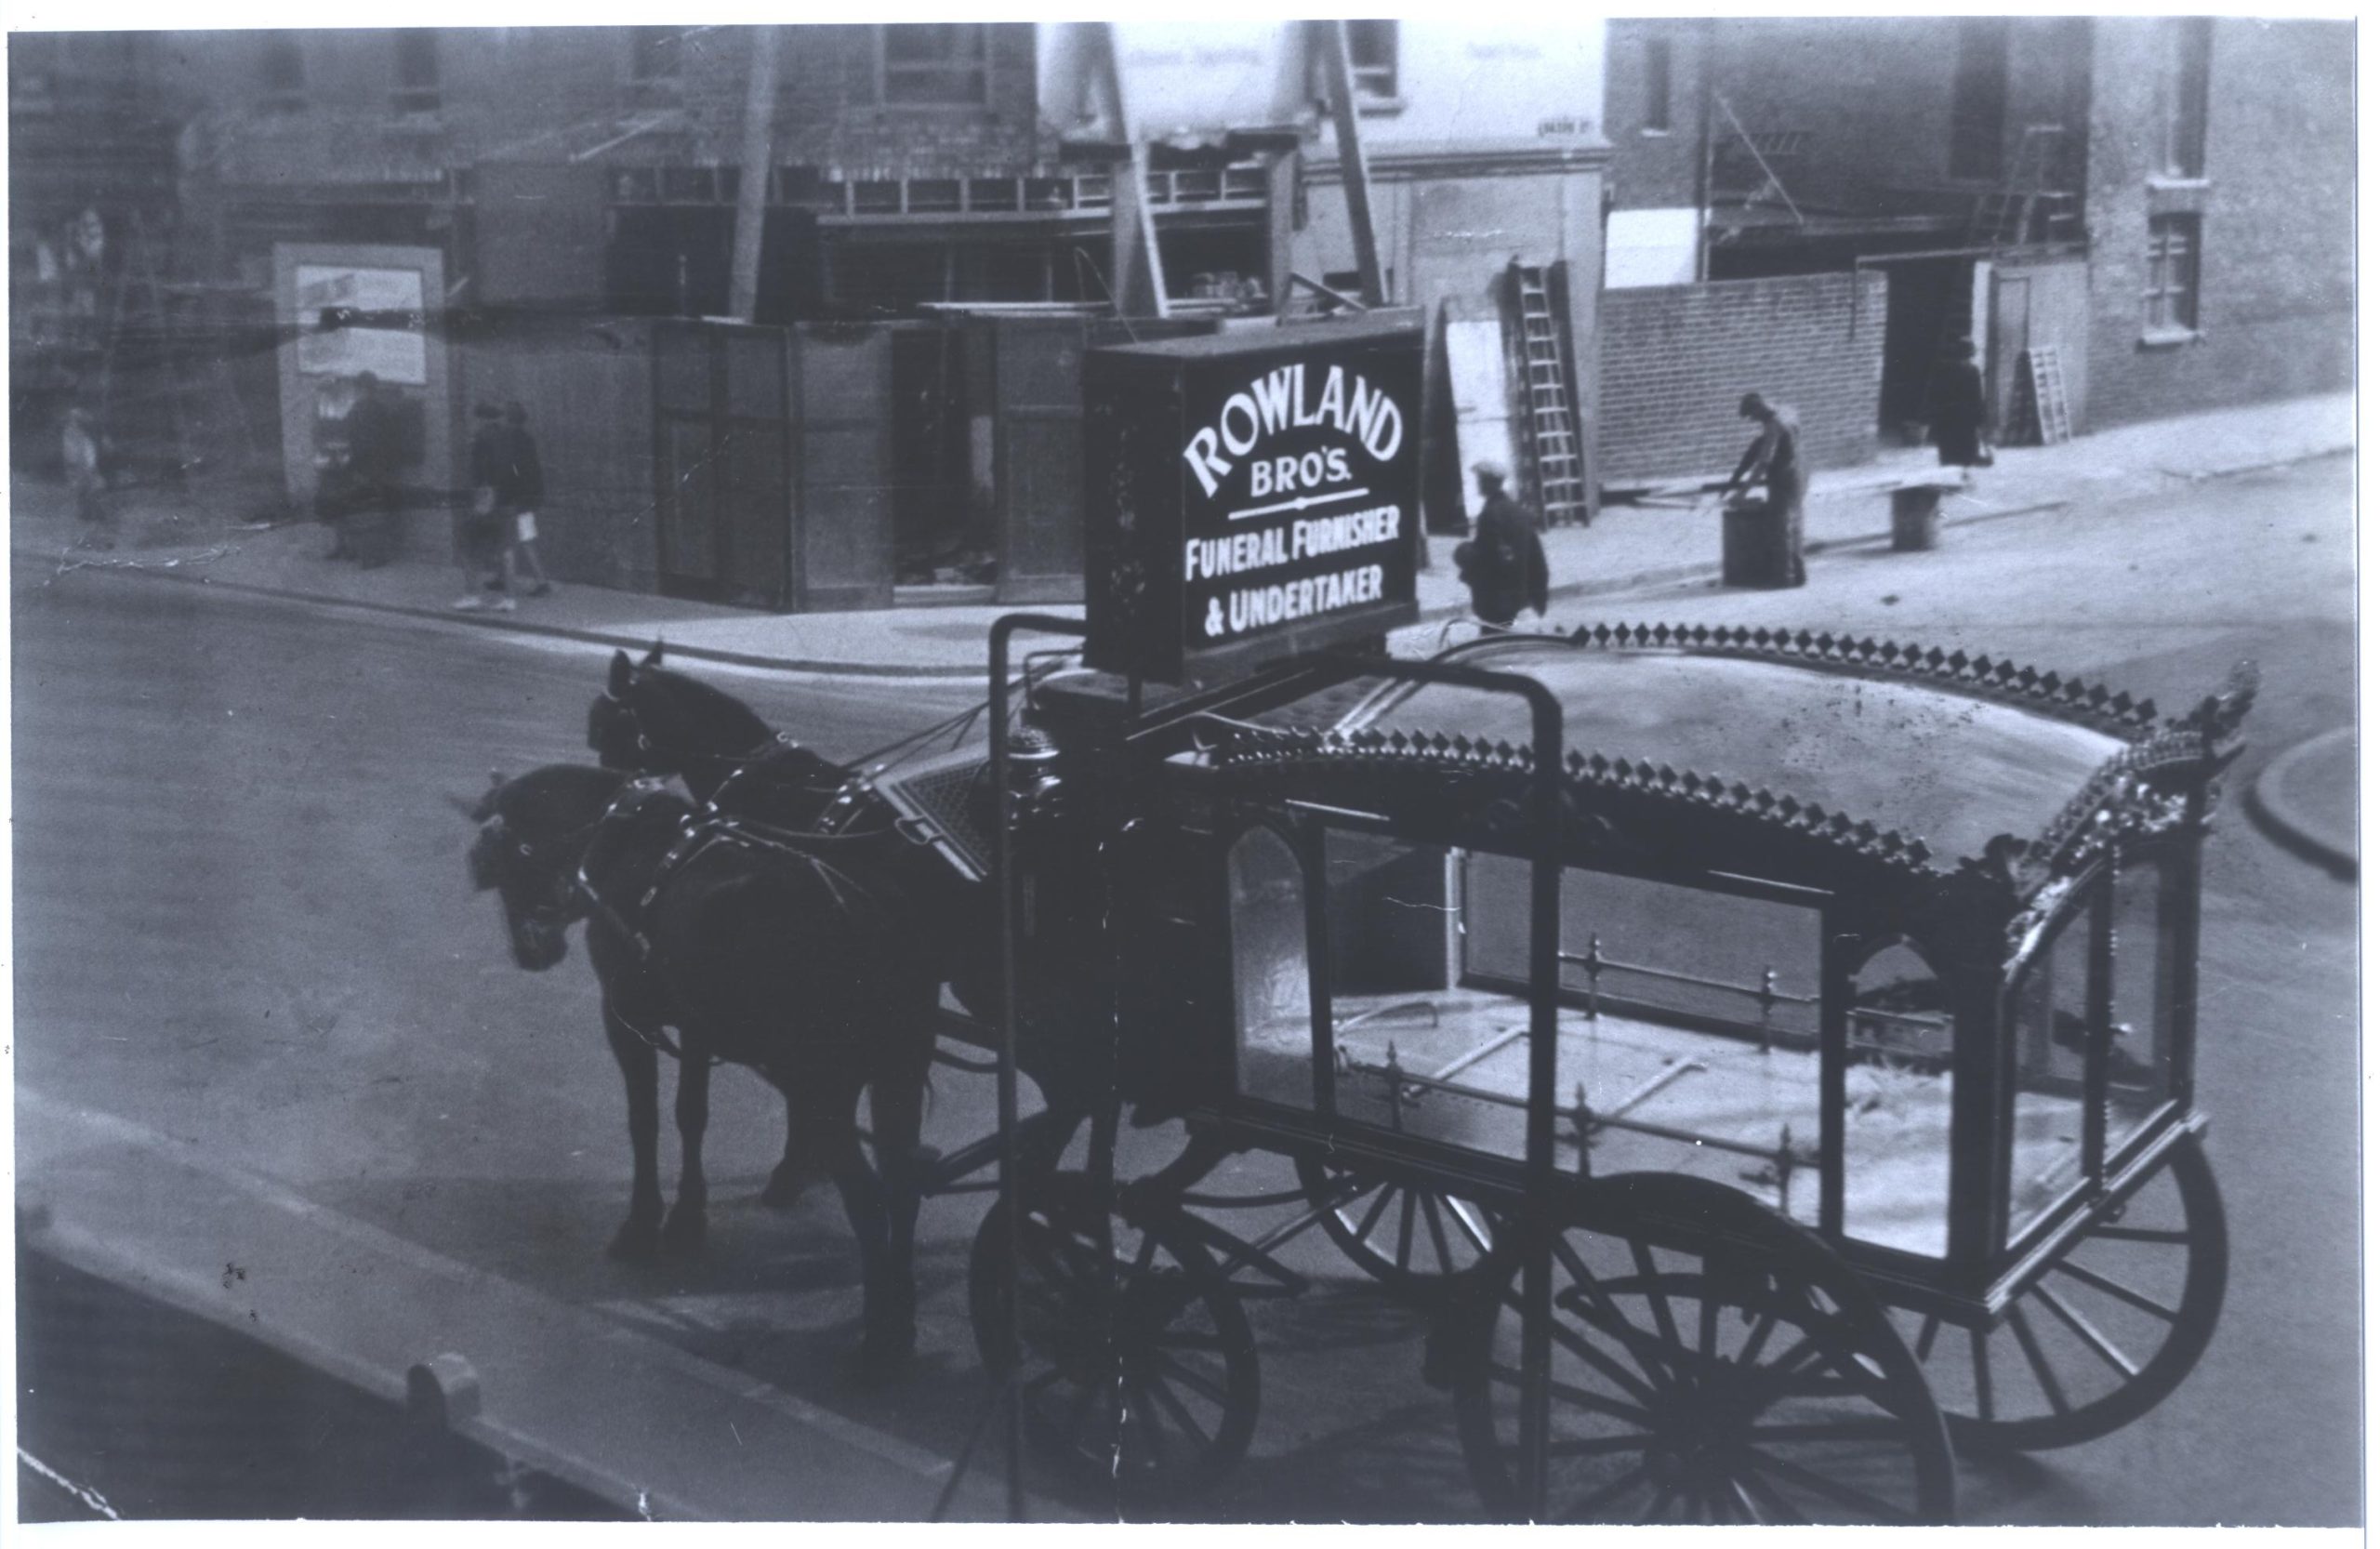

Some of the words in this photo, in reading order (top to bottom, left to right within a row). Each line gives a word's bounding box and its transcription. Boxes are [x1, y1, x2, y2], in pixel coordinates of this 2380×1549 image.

[1183, 364, 1403, 498] ROWLAND
[1186, 528, 1288, 581] FUNERAL
[1292, 505, 1400, 560] FURNISHER
[1205, 597, 1224, 636] &
[1230, 564, 1383, 632] UNDERTAKER
